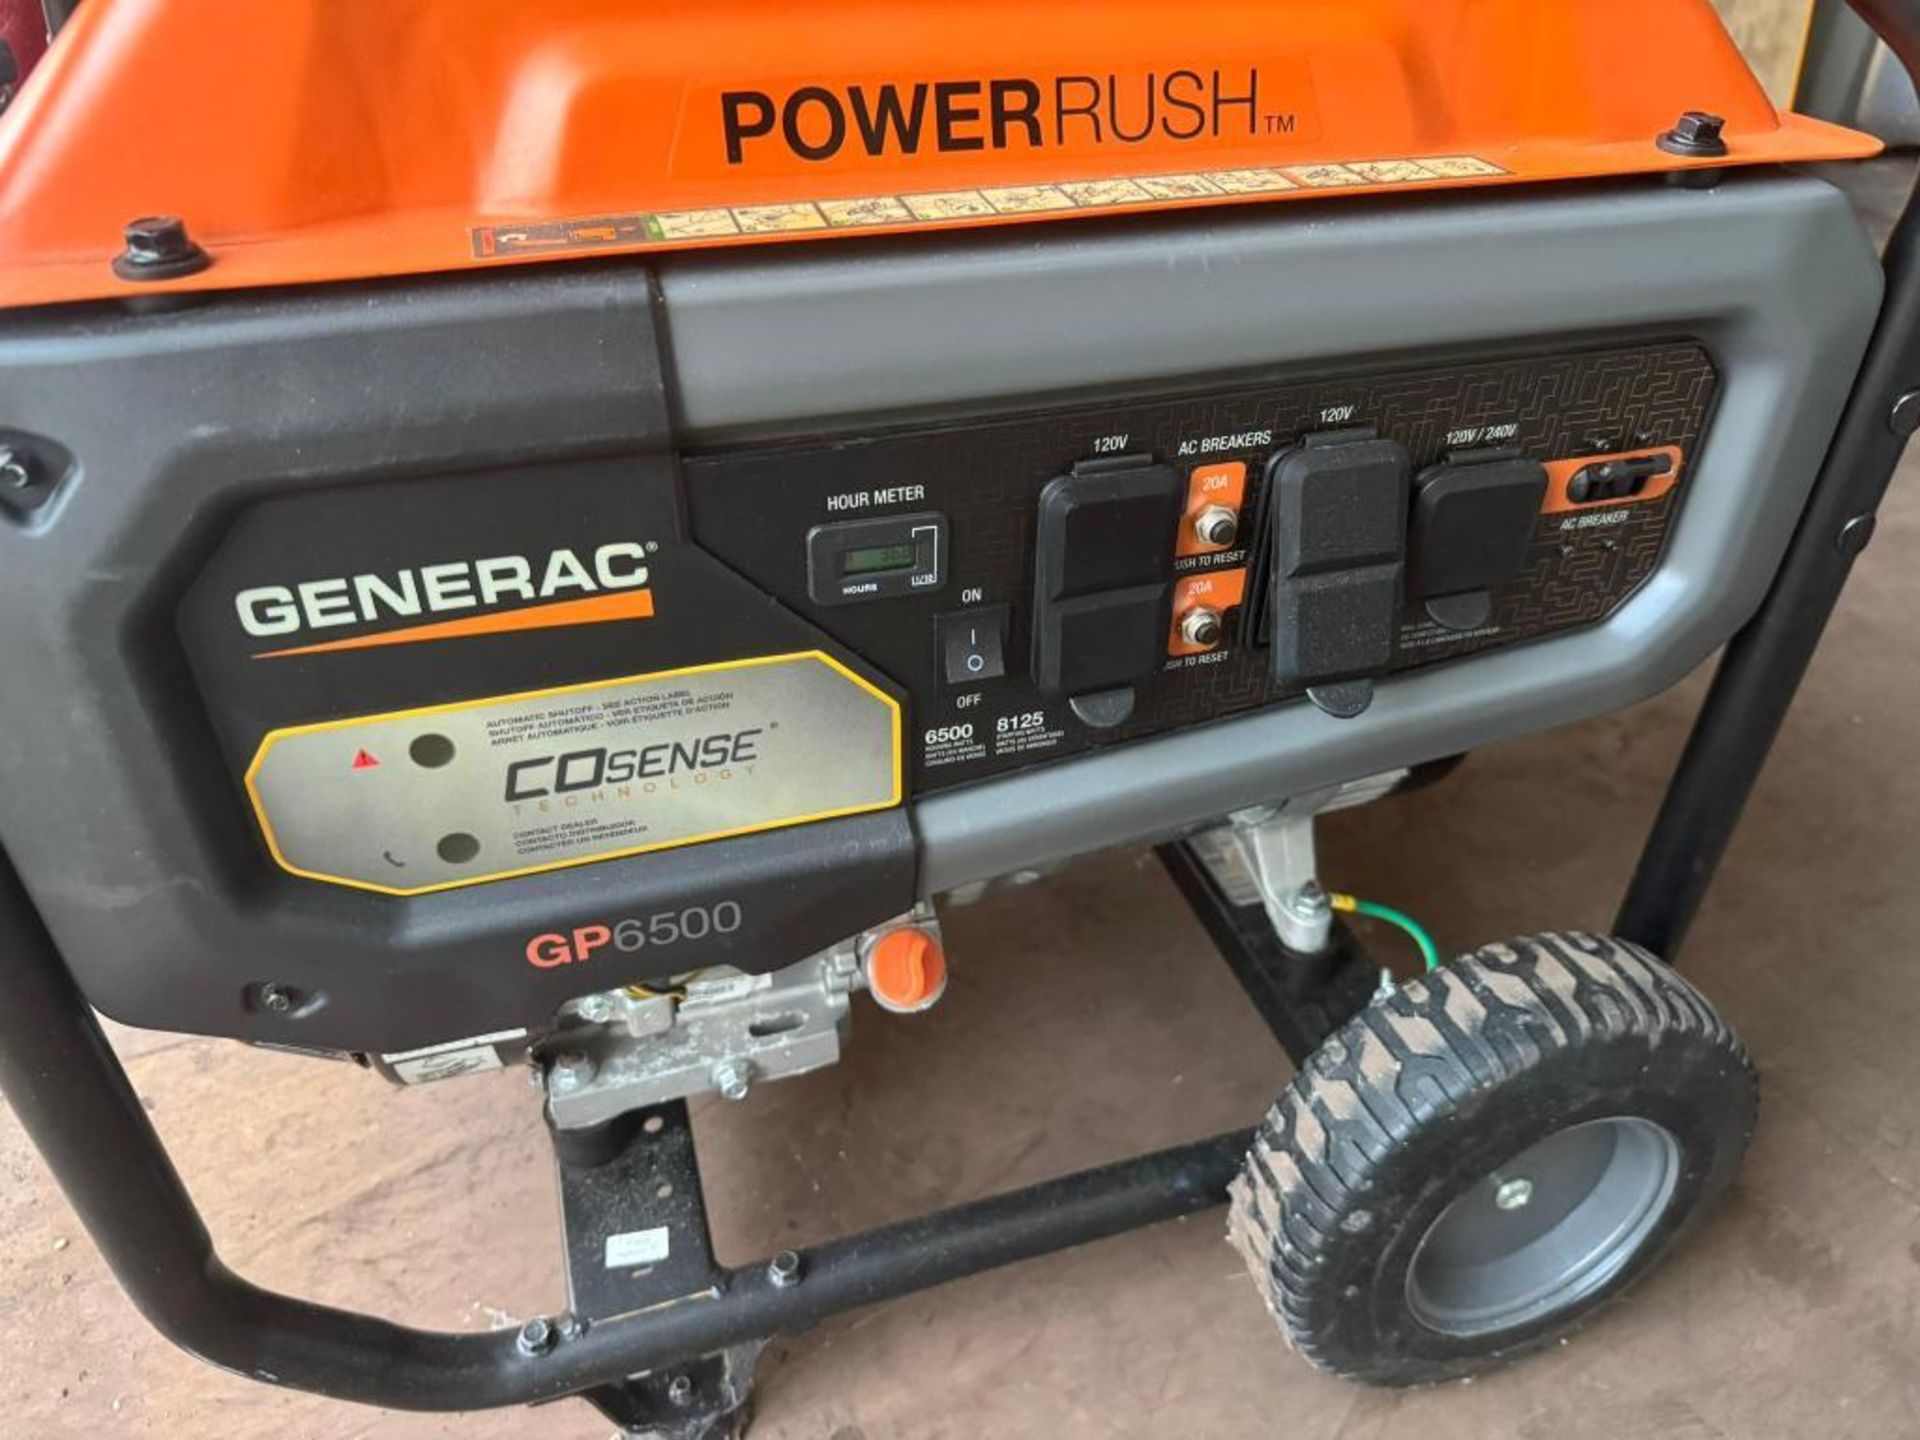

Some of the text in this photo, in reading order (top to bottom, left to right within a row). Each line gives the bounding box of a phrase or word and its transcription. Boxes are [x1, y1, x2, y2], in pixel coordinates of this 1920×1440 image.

[1320, 406, 1354, 423] 120V
[1093, 434, 1129, 452] 120V
[1178, 430, 1272, 456] AC BREAKERS
[1446, 430, 1478, 445] 120V
[1486, 424, 1518, 438] 240V
[1202, 475, 1229, 491] 20A
[827, 485, 925, 511] HOUR METER
[1559, 510, 1630, 531] AC BREAKER
[1173, 550, 1246, 571] USH TO RESET
[842, 583, 879, 596] HOURS
[961, 588, 983, 603] ON
[1188, 581, 1213, 596] 20A
[1185, 656, 1196, 668] TO
[1199, 651, 1229, 666] RESET
[487, 712, 546, 729] AUTOMATIC
[547, 704, 593, 720] SHUTOFF
[624, 692, 660, 707] ACTION
[956, 693, 982, 709] OFF
[489, 724, 535, 738] SHUTOFF
[997, 711, 1044, 733] 8125
[528, 723, 598, 741] AUTOMATIQUE
[925, 723, 974, 745] 6500
[511, 765, 757, 817] TECHNOLOGY
[525, 900, 742, 969] GP6500
